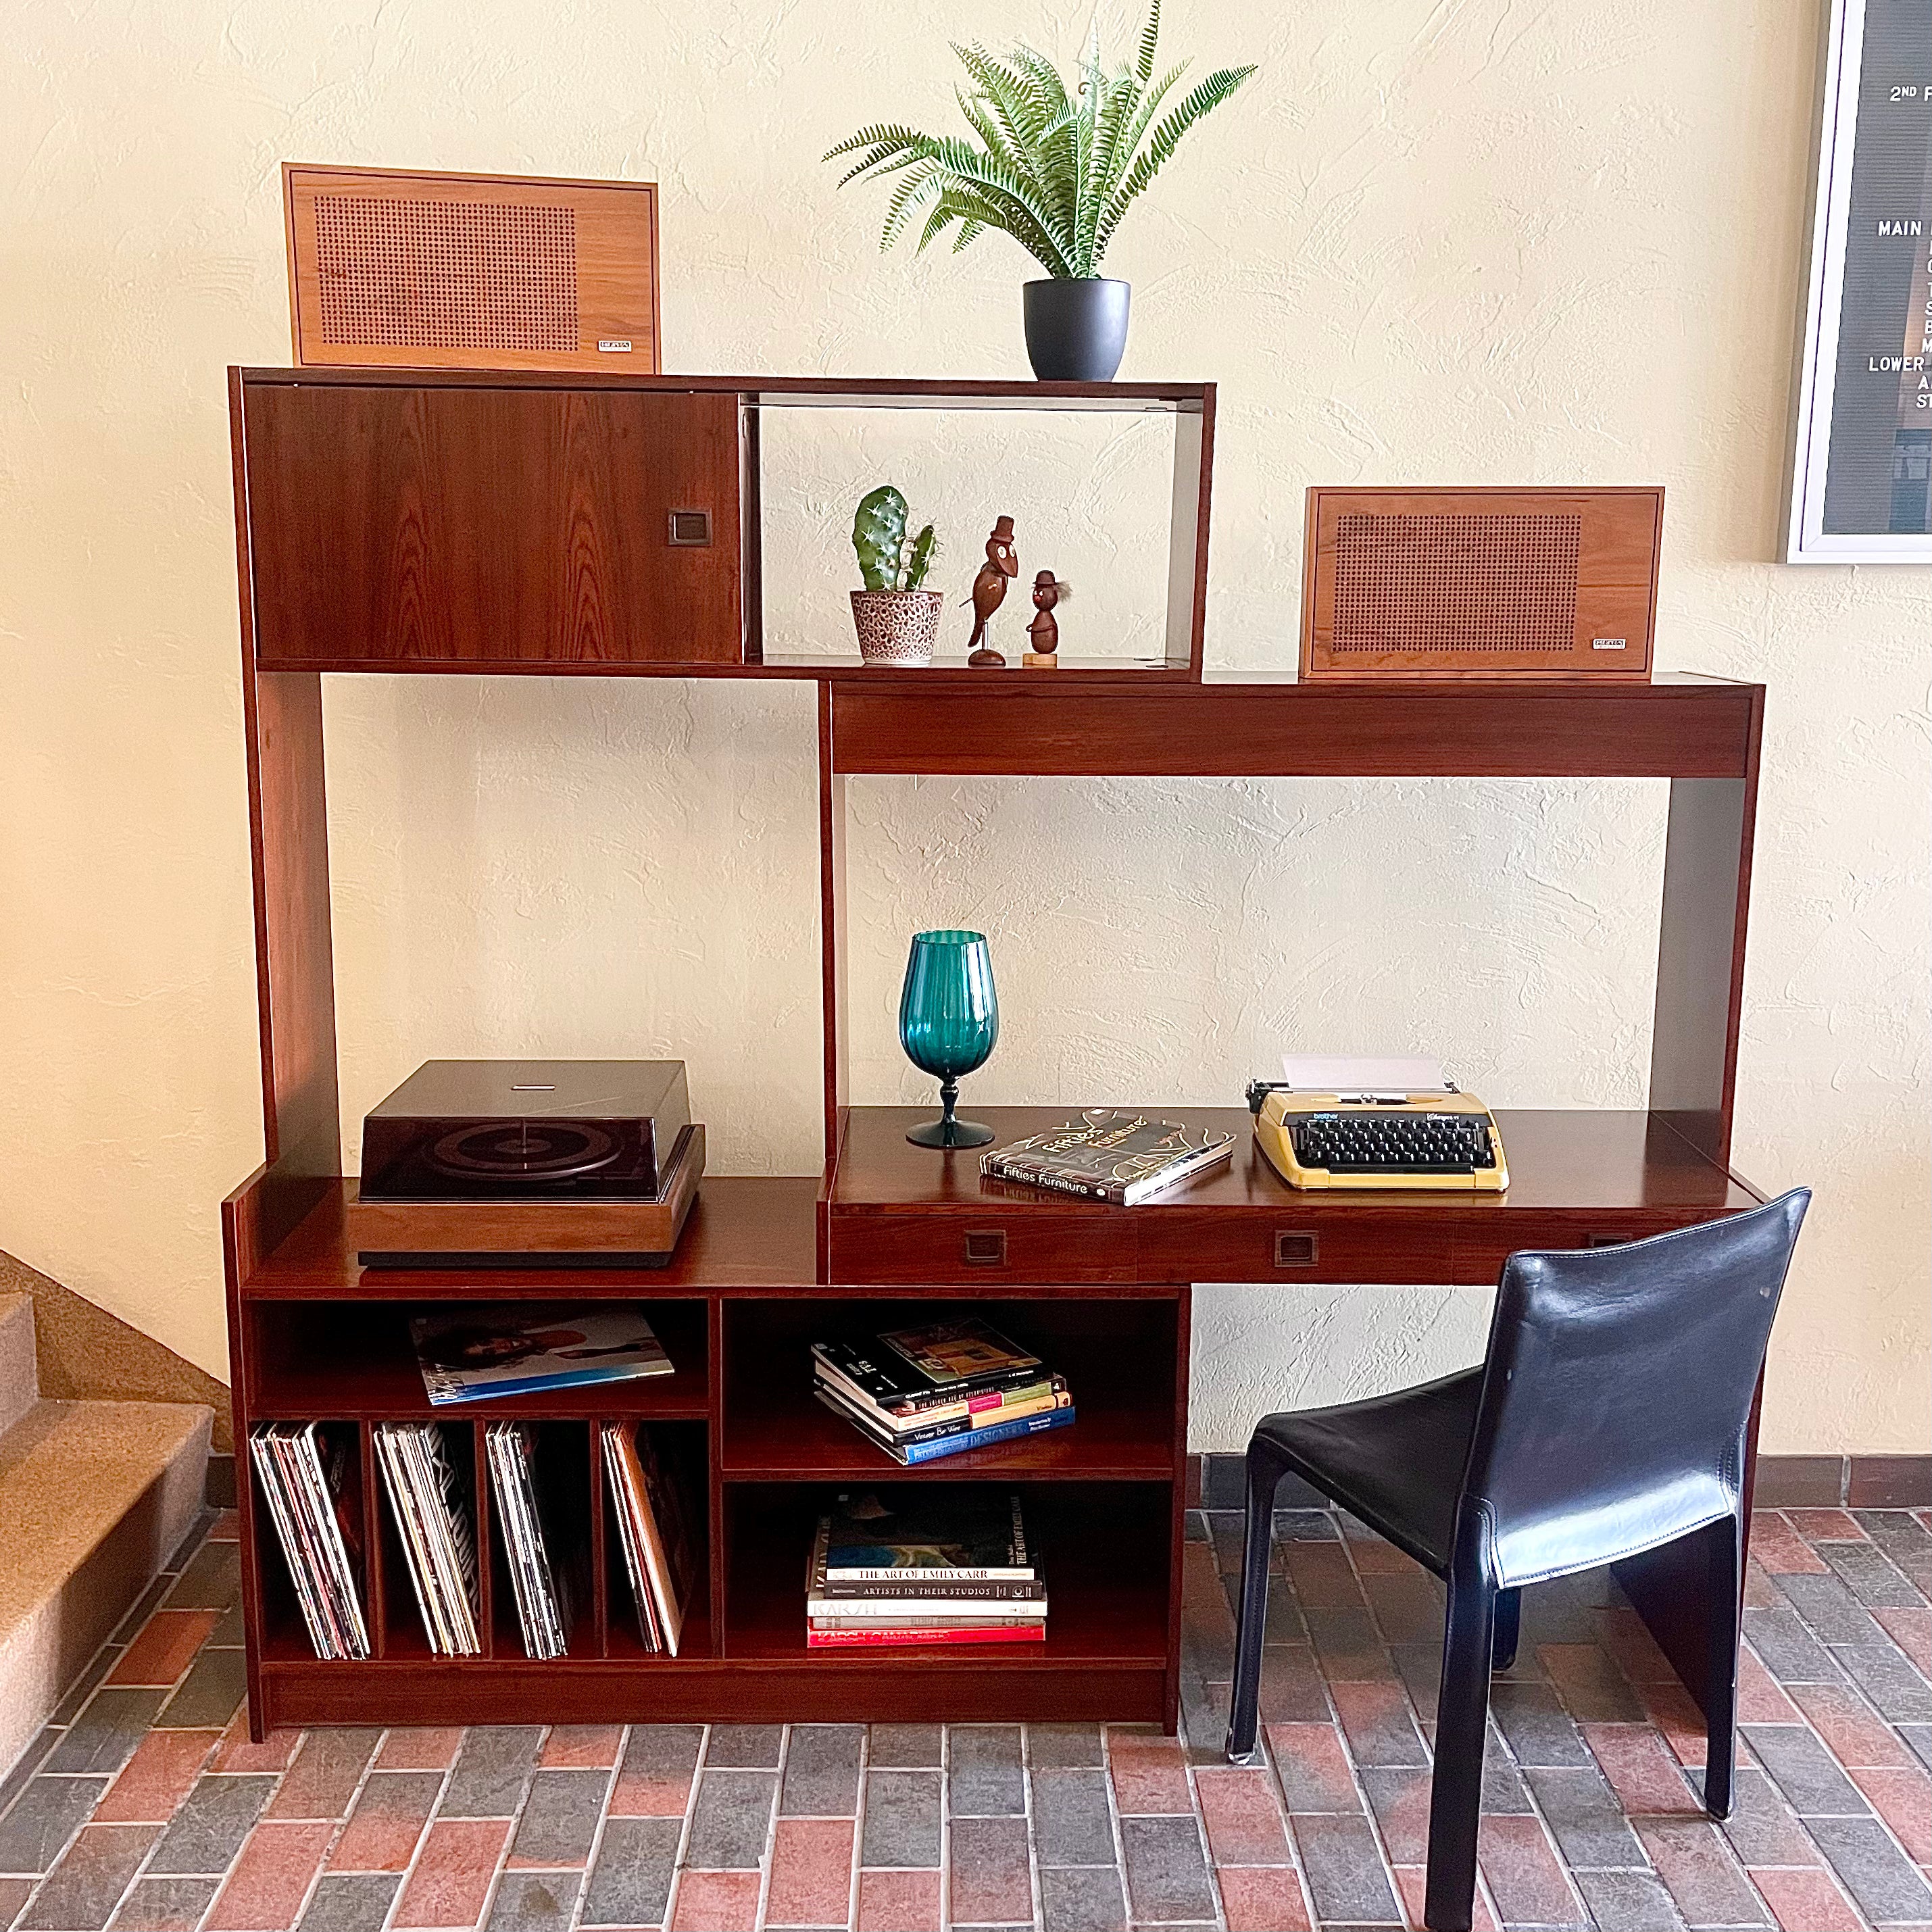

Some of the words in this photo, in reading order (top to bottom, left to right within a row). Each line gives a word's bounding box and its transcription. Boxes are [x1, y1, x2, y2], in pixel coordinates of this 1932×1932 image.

[1889, 86, 1917, 101] 2ND
[1878, 220, 1922, 237] MAIN
[1868, 356, 1925, 372] LOWER
[1041, 1126, 1105, 1153] Fifties
[1088, 1115, 1147, 1149] Furniture
[1003, 1164, 1035, 1183] Fifties
[1039, 1173, 1088, 1194] Furniture
[859, 1570, 879, 1579] THE
[883, 1570, 905, 1579] ART
[906, 1570, 920, 1579] OF
[923, 1570, 956, 1579] EMILY
[957, 1570, 988, 1579] CARR
